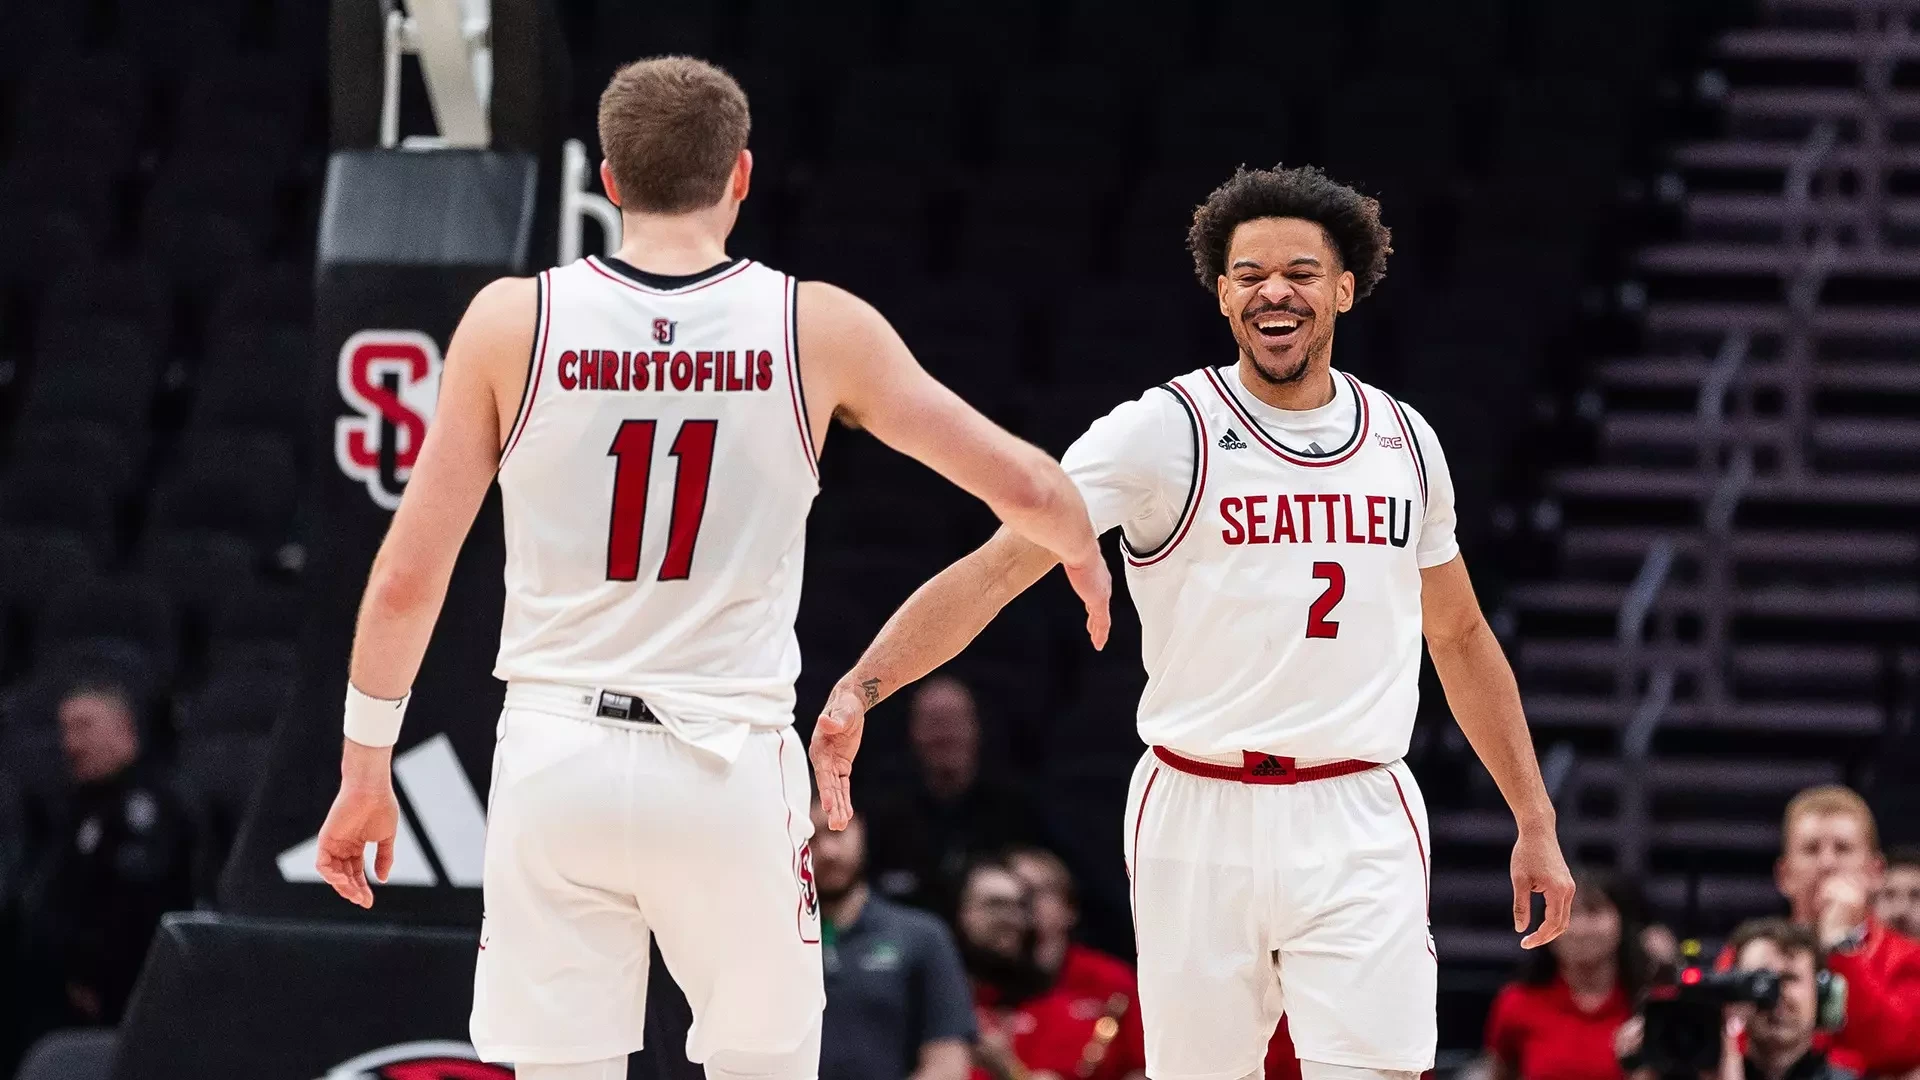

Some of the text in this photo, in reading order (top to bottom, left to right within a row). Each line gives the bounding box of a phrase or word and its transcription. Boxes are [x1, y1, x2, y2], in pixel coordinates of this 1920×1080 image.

[558, 349, 773, 391] CHRISTOFILIS
[605, 419, 718, 581] 11
[1219, 494, 1412, 548] SEATTLEU
[1305, 561, 1346, 639] 2
